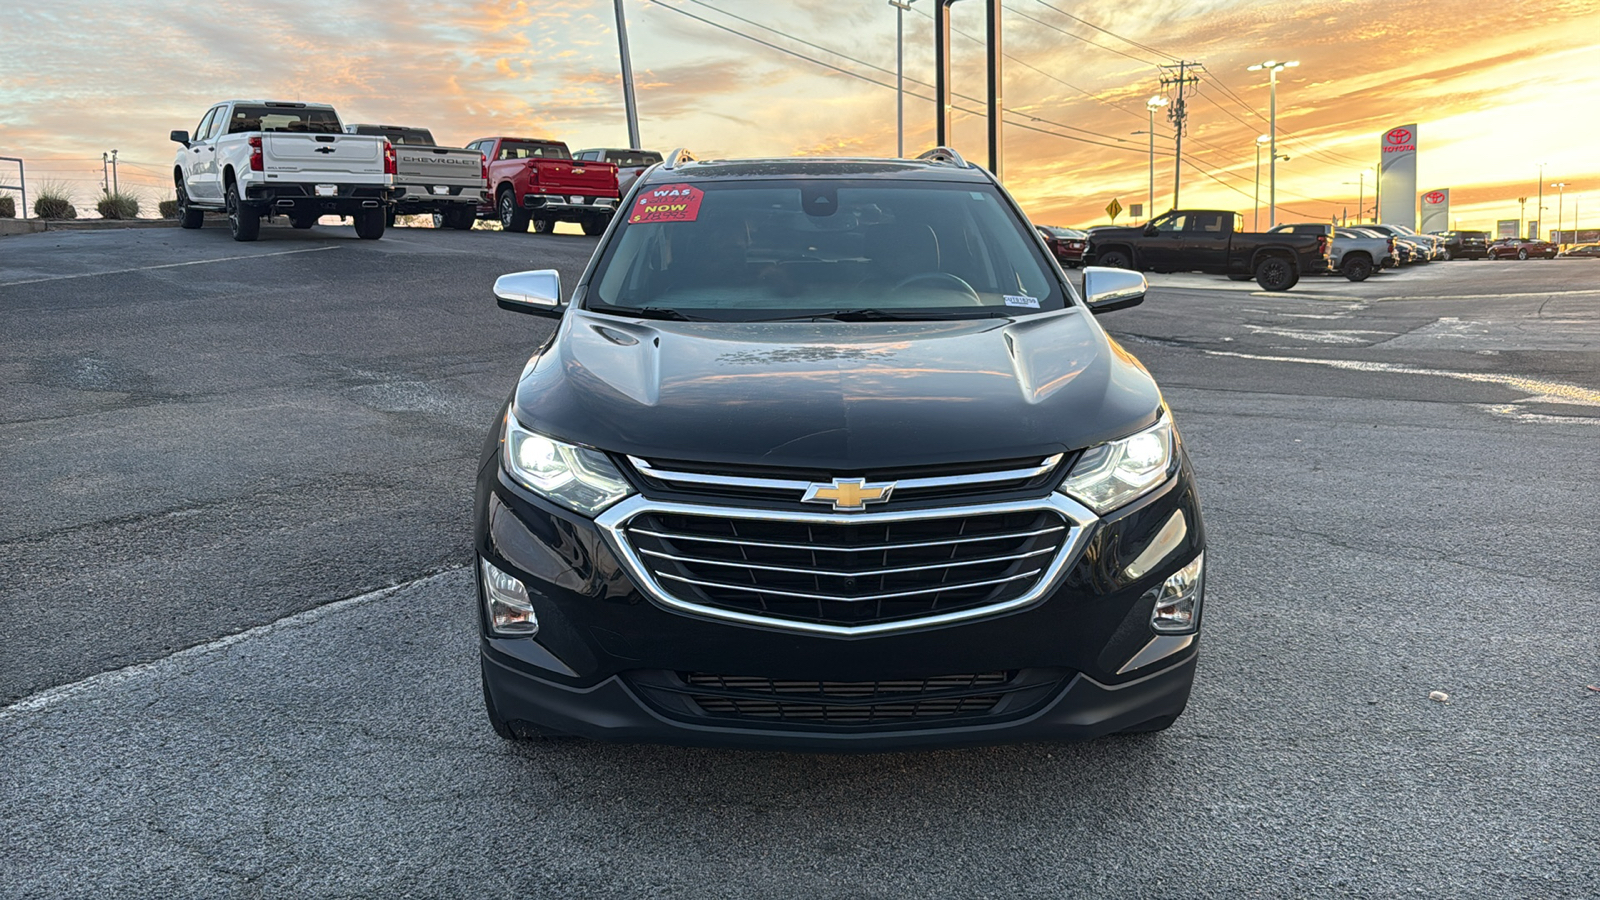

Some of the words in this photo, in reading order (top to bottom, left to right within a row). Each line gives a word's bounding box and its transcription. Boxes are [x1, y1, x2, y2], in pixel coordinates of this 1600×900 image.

[1382, 144, 1415, 153] TOYOTA
[403, 156, 476, 165] CHEVROLET
[653, 189, 691, 197] WAS
[644, 204, 687, 213] NOW
